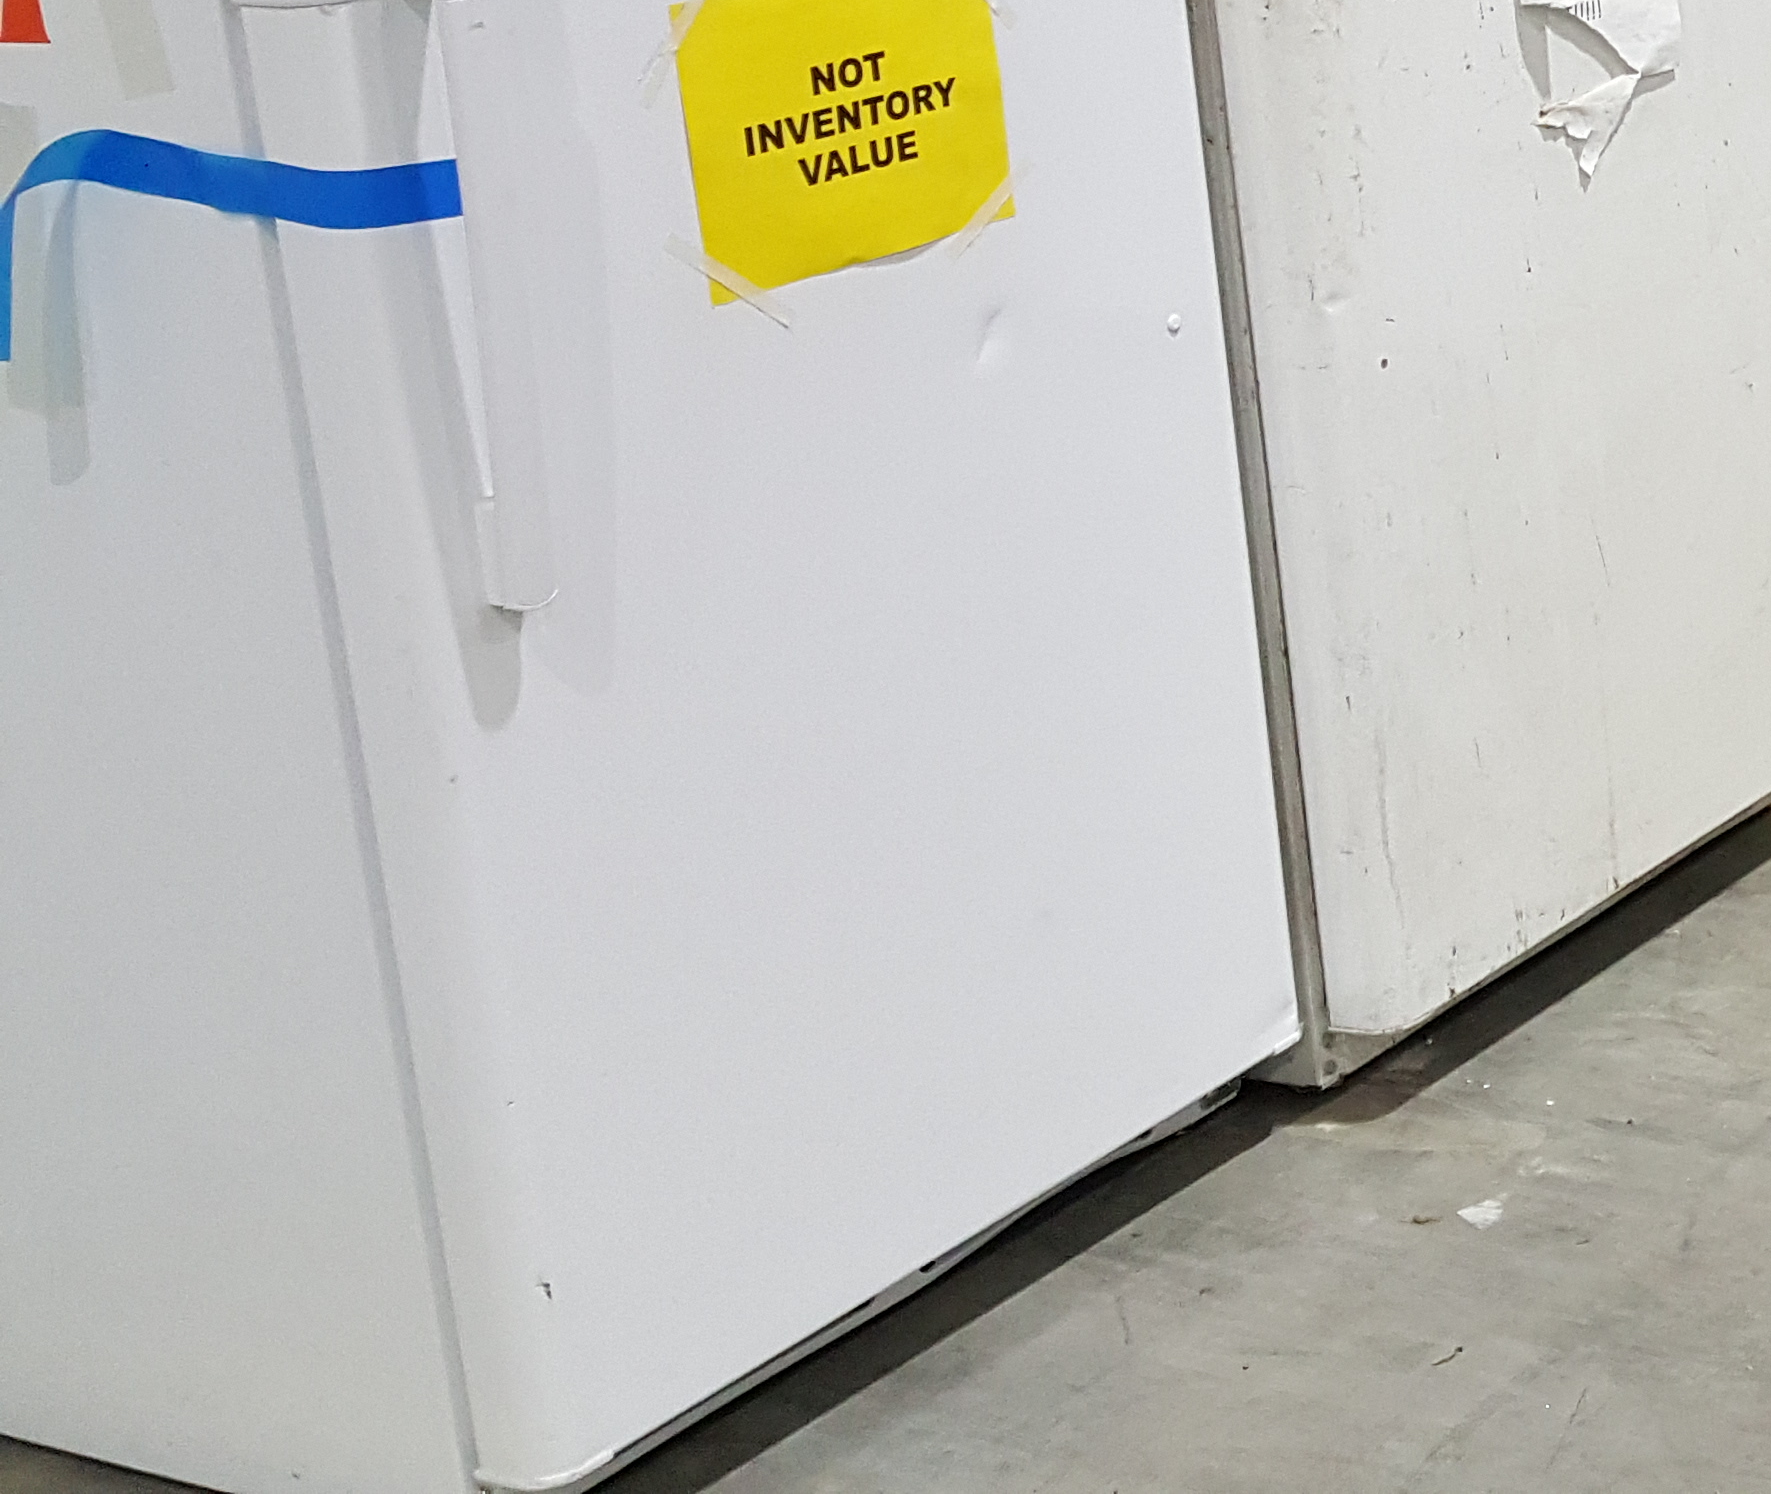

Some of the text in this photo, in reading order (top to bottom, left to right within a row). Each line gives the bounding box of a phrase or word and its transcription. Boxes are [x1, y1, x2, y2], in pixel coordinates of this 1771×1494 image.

[809, 50, 886, 96] NOT
[743, 77, 956, 158] INVENTORY
[797, 130, 919, 187] VALUE
